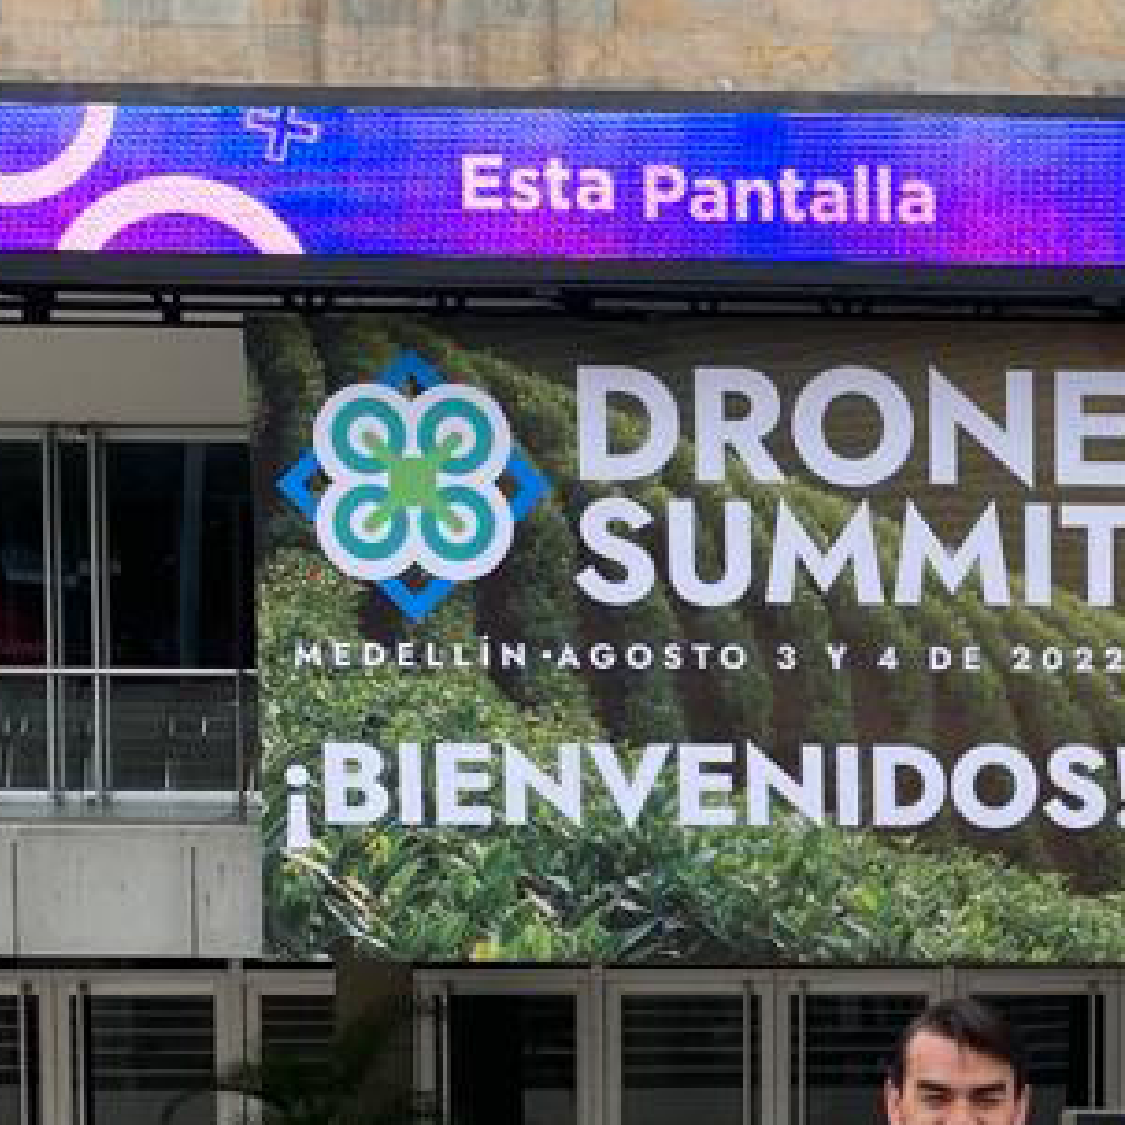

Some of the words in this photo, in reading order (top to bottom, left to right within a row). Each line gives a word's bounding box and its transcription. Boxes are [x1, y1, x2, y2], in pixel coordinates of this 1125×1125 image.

[461, 153, 615, 210] Esta
[641, 163, 938, 224] Pantalla
[777, 643, 796, 670] 3
[827, 646, 847, 670] Y
[878, 646, 900, 670] 4
[930, 646, 982, 670] DE
[1012, 646, 1125, 671] 2022
